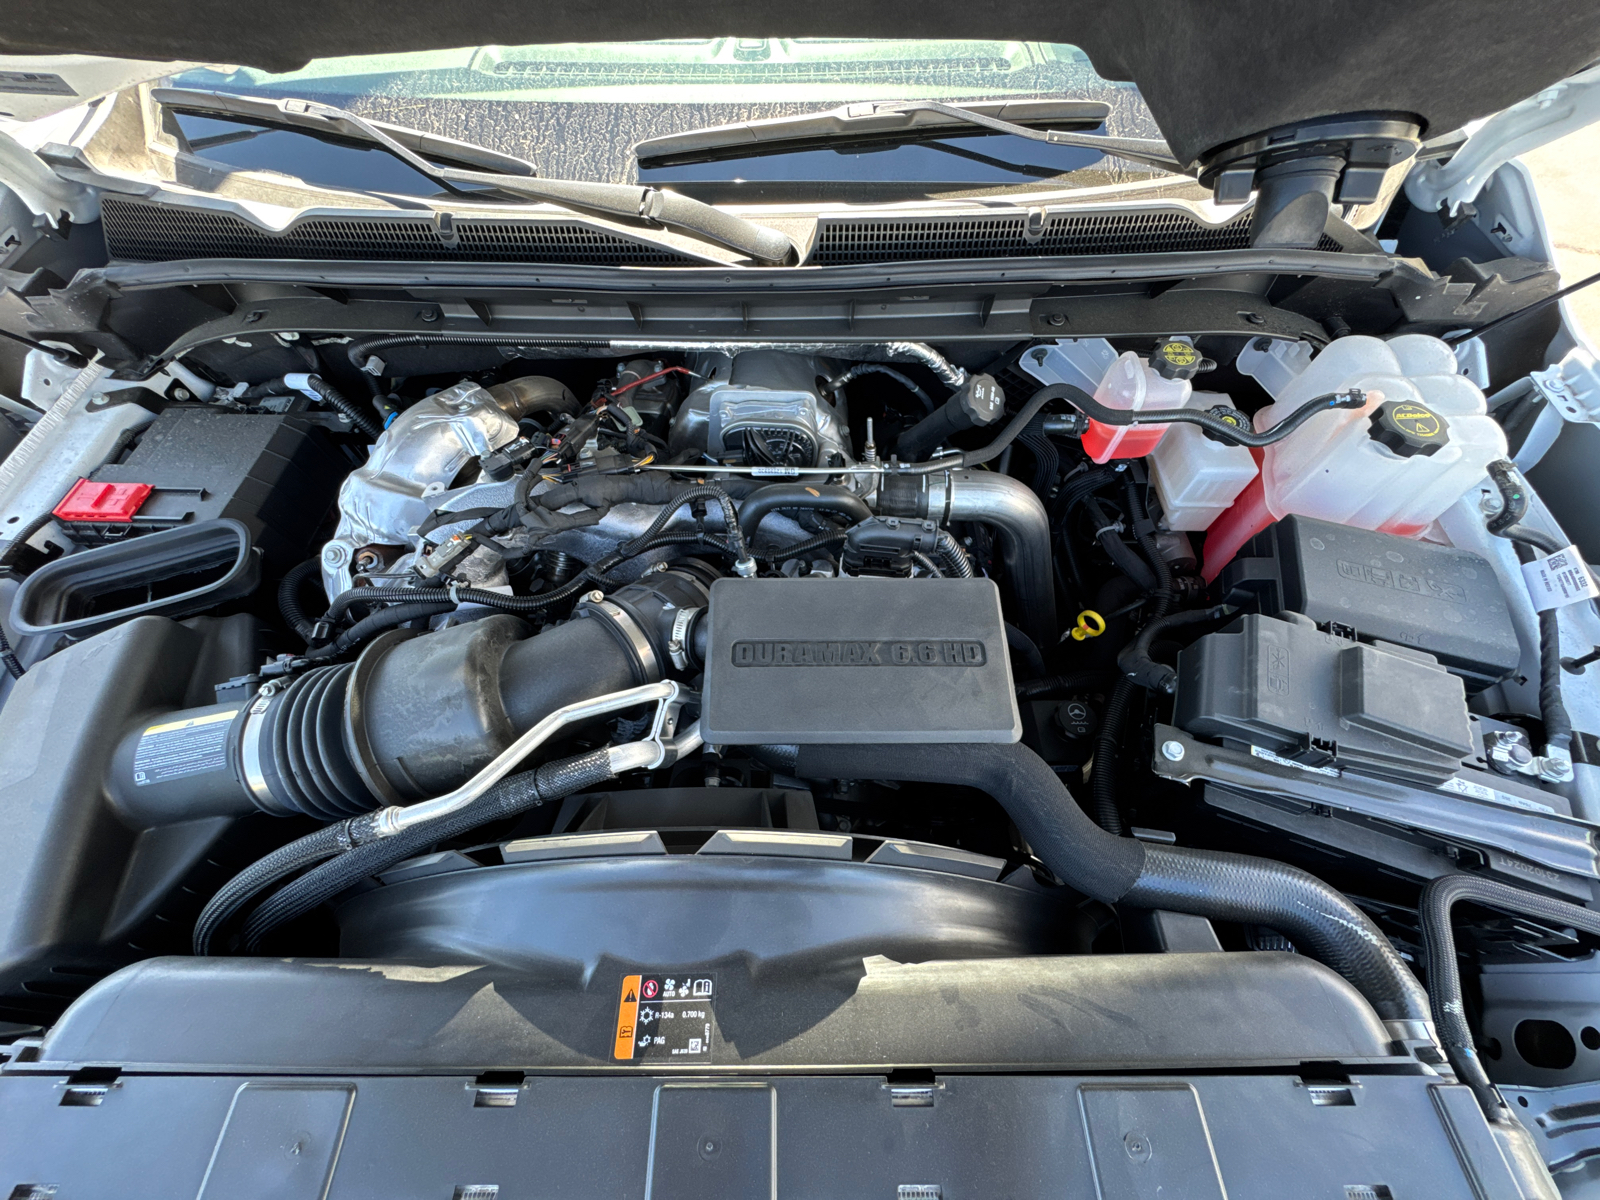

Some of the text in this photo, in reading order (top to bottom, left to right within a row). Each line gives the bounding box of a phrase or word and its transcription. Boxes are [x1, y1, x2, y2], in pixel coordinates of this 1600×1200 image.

[734, 641, 985, 665] DURAMAX 6.6 HD
[1499, 856, 1560, 882] 23102024T
[698, 1011, 705, 1019] kg
